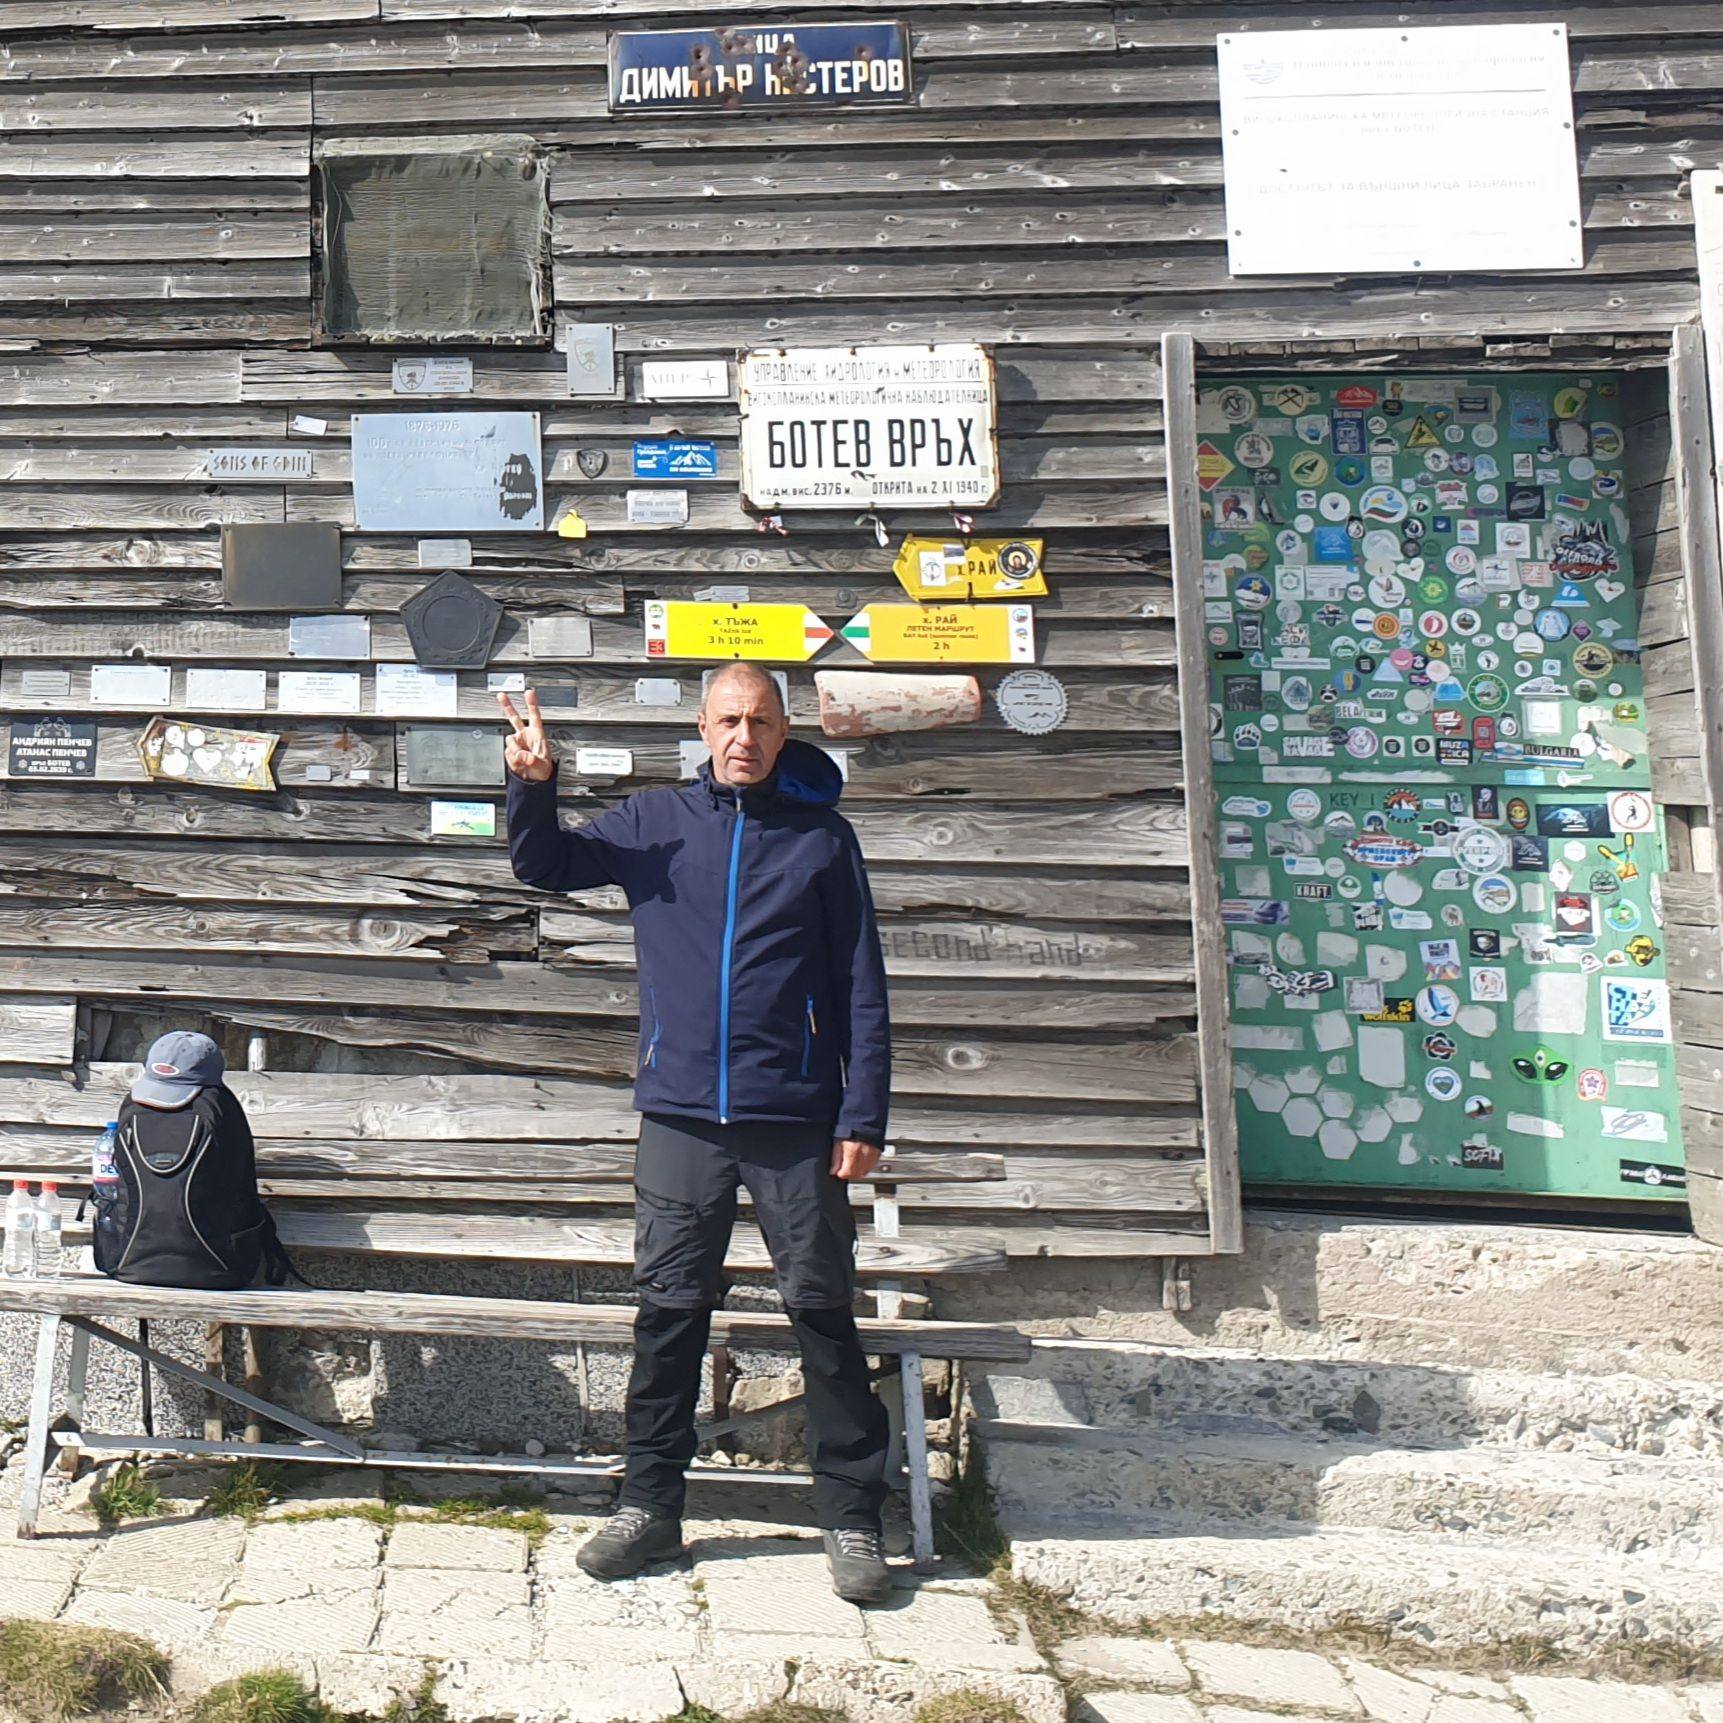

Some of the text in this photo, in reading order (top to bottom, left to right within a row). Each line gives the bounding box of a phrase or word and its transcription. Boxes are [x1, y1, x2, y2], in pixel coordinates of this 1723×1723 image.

[765, 59, 905, 96] НСТЕРОВ
[768, 418, 977, 468] БОТЕВ ВРЪХ
[813, 482, 842, 496] 2376
[871, 481, 914, 495] ОТКРИТА
[930, 481, 938, 494] 2
[956, 480, 980, 494] 1940
[968, 558, 997, 575] РАЙ
[726, 617, 758, 627] ТЪЖА
[935, 614, 958, 624] РАЙ
[708, 635, 764, 645] 3 h 10 min
[933, 642, 950, 650] 2 h
[57, 737, 93, 747] ПЕНЧЕВ
[16, 748, 88, 757] АТАНАС ПЕНЧЕВ
[1524, 744, 1580, 757] BULGARIA
[47, 759, 71, 767] БОТЕВ
